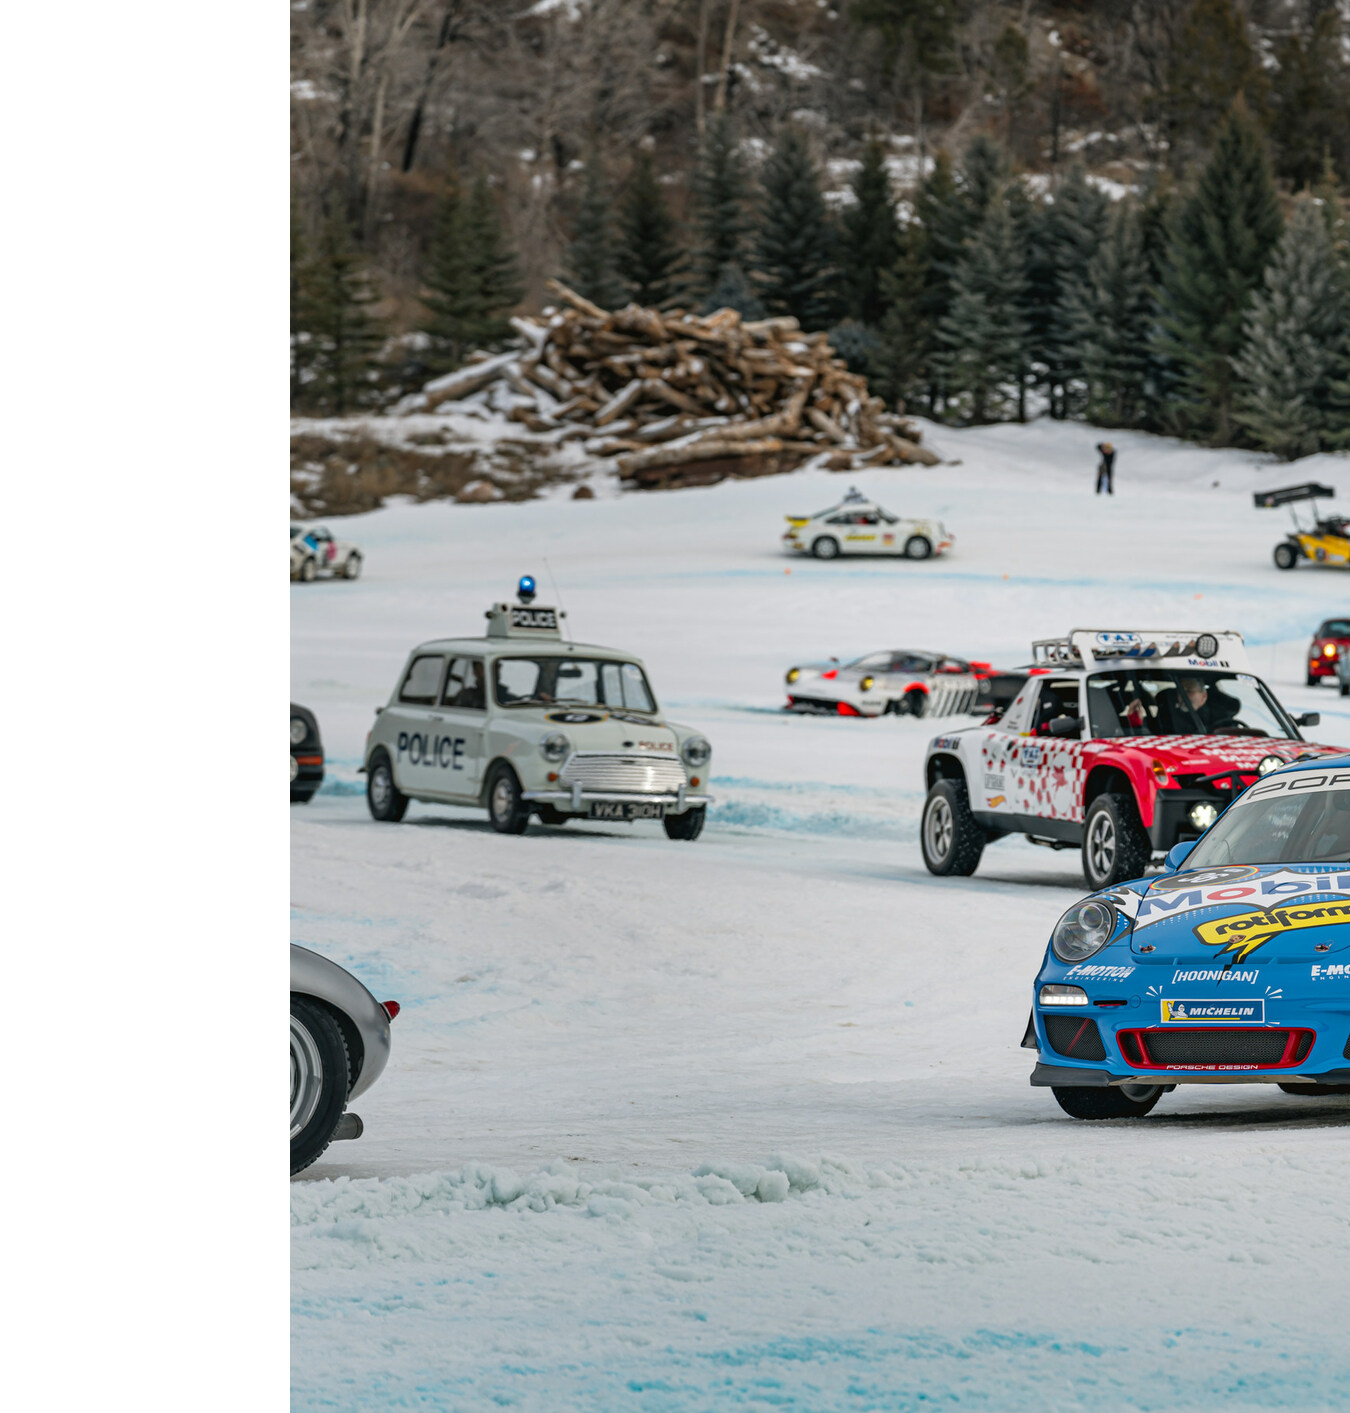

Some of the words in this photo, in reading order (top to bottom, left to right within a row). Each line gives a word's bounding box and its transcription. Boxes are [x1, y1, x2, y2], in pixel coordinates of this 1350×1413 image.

[512, 611, 556, 627] POLICE
[1188, 658, 1219, 667] Mobil
[397, 731, 466, 771] POLICE
[638, 741, 674, 751] POLICE
[594, 803, 624, 818] VKA
[1066, 964, 1136, 979] E-MOTION
[1189, 1006, 1255, 1016] MICHELIN
